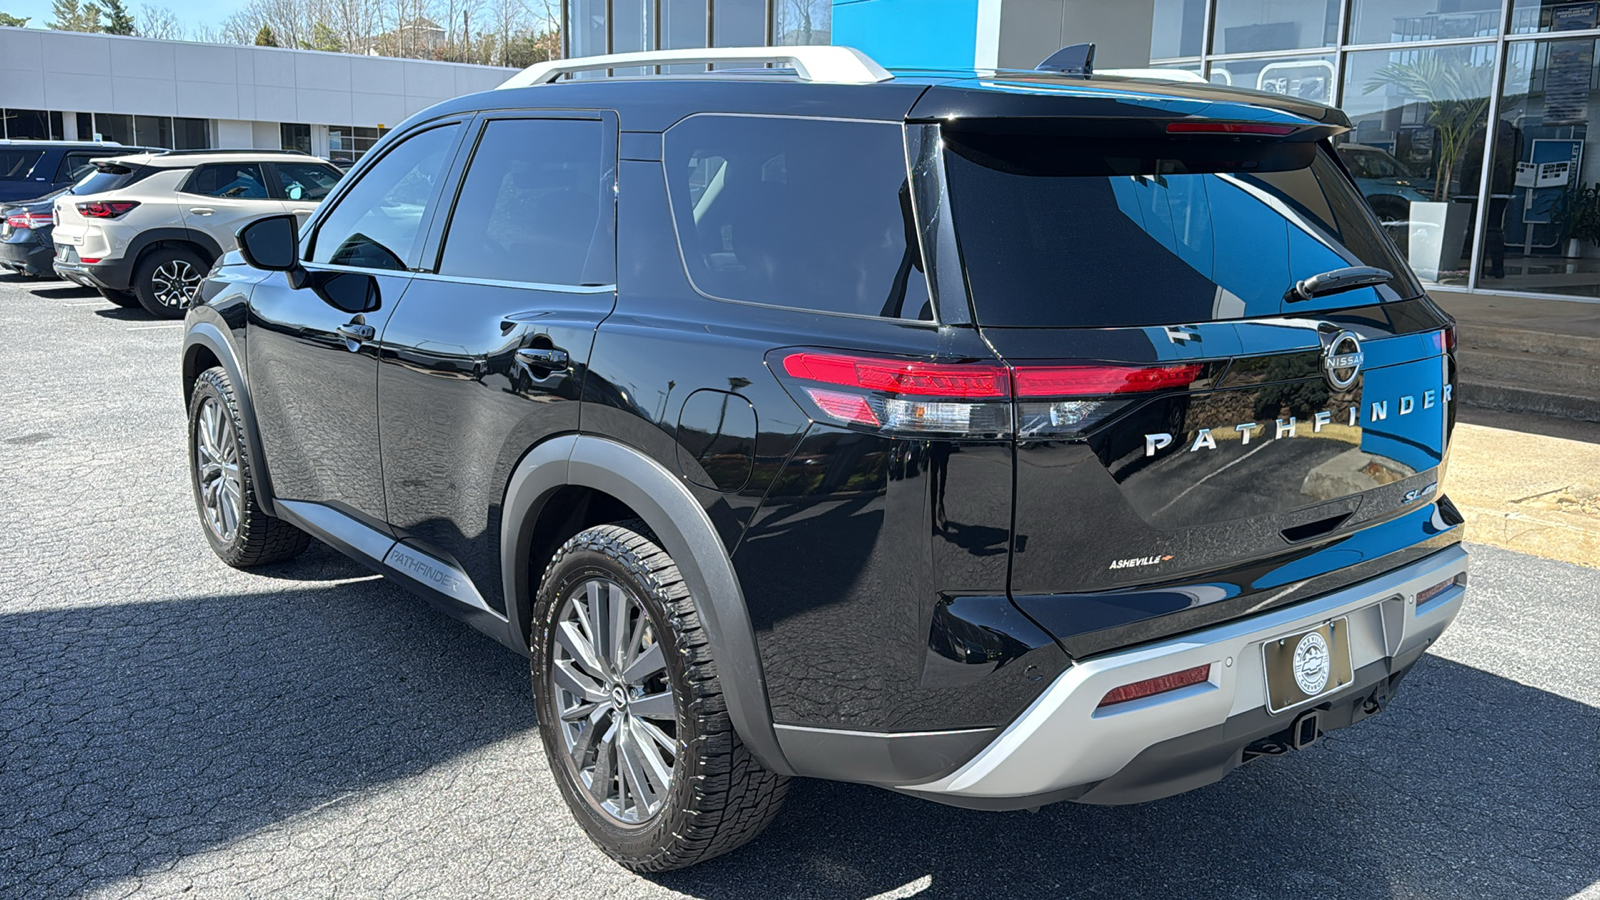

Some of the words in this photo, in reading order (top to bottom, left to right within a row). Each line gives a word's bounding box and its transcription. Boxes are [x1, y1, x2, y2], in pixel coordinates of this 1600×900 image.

[1327, 354, 1364, 367] NISSAN
[1144, 383, 1453, 456] PATHFINDER
[390, 550, 461, 592] PATHFINDER
[1109, 555, 1162, 569] ASHEVILLE
